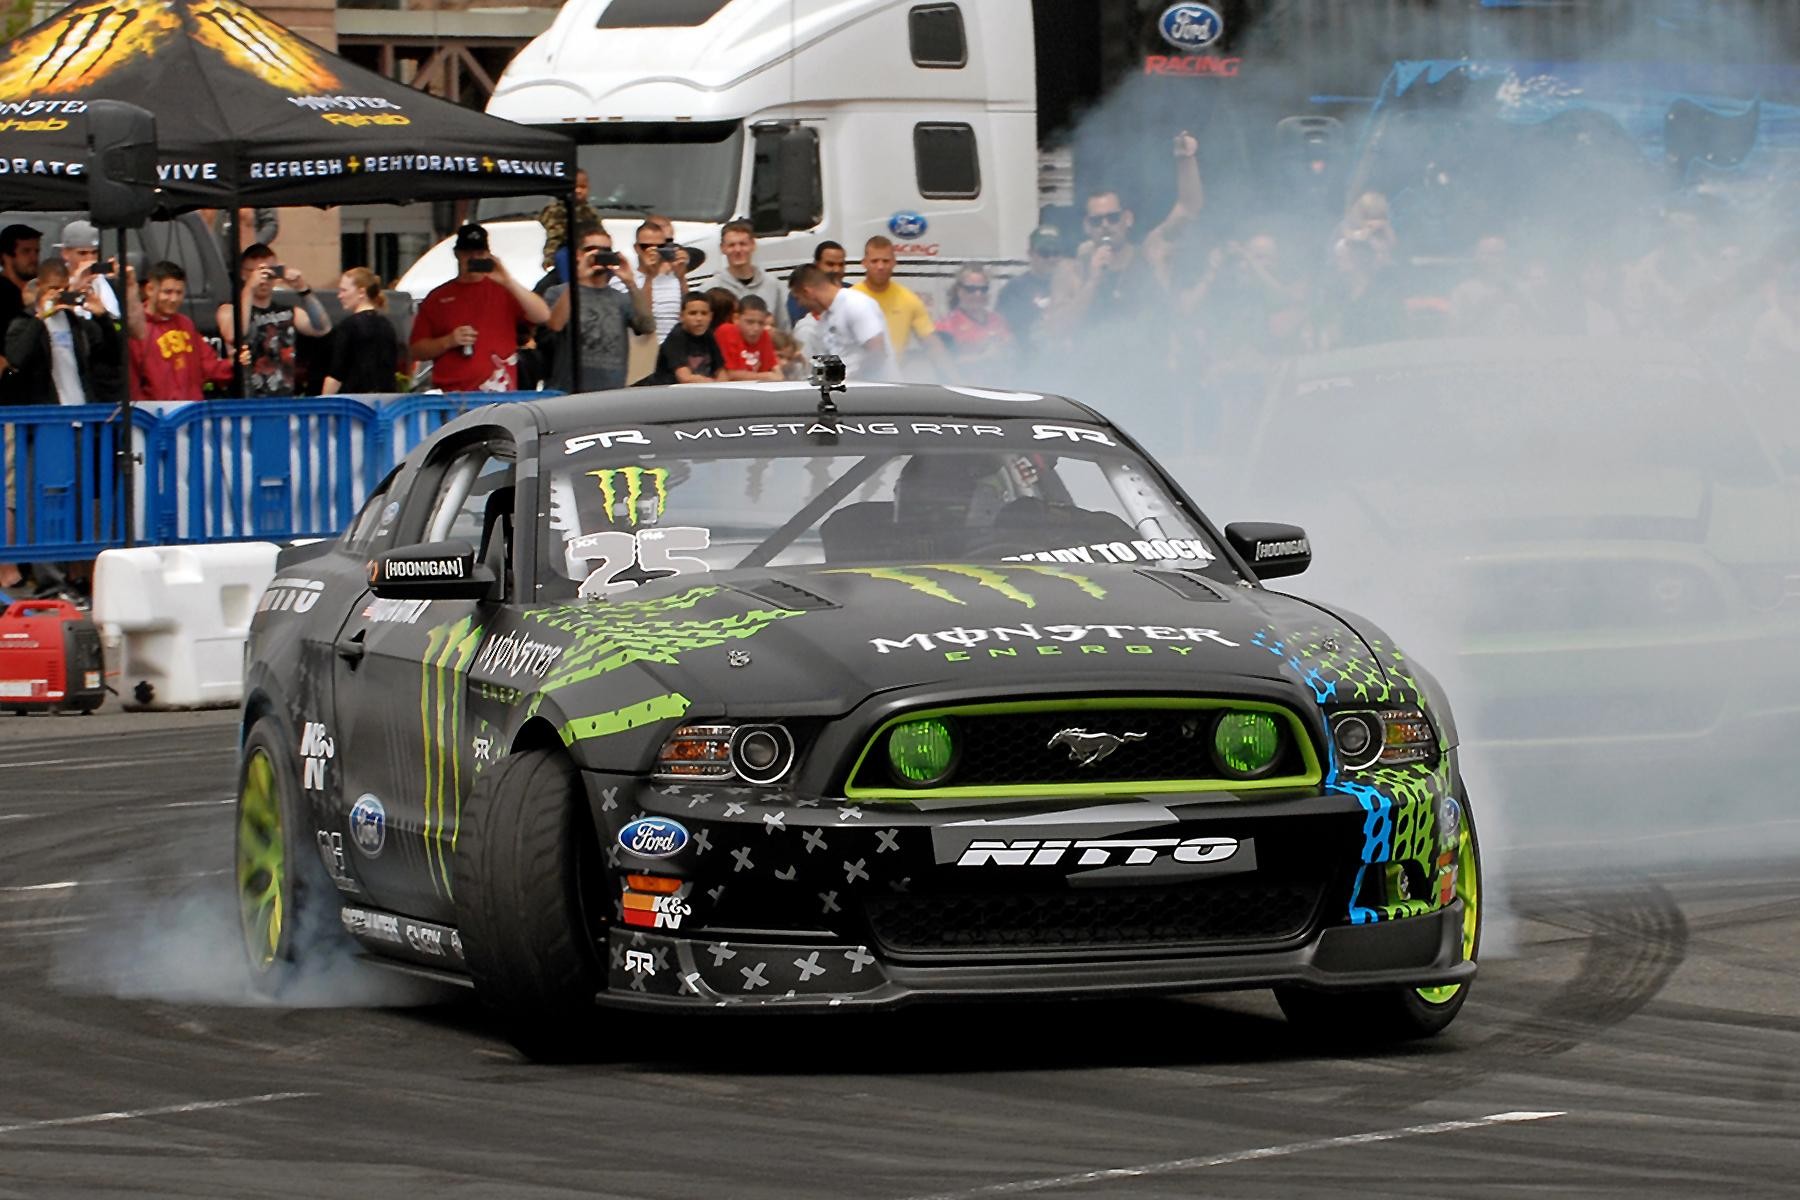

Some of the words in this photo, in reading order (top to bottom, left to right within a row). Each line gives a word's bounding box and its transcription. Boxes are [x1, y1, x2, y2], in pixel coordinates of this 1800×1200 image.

[1172, 9, 1211, 40] Ford
[1144, 55, 1243, 77] RACING
[0, 99, 88, 115] NSTE
[0, 118, 68, 131] hab
[156, 163, 218, 180] VIVE
[250, 159, 343, 178] REFRESH
[364, 155, 479, 173] REHYDRATE
[497, 159, 565, 177] REVIVE
[892, 244, 939, 256] ACING
[674, 422, 899, 441] MUSTANG
[911, 423, 1004, 436] RTR
[1091, 541, 1137, 563] TO
[1130, 540, 1216, 561] ROCK
[566, 527, 710, 599] 25
[945, 645, 1193, 661] ENERGY
[632, 822, 675, 850] Ford
[956, 837, 1238, 866] NITTO
